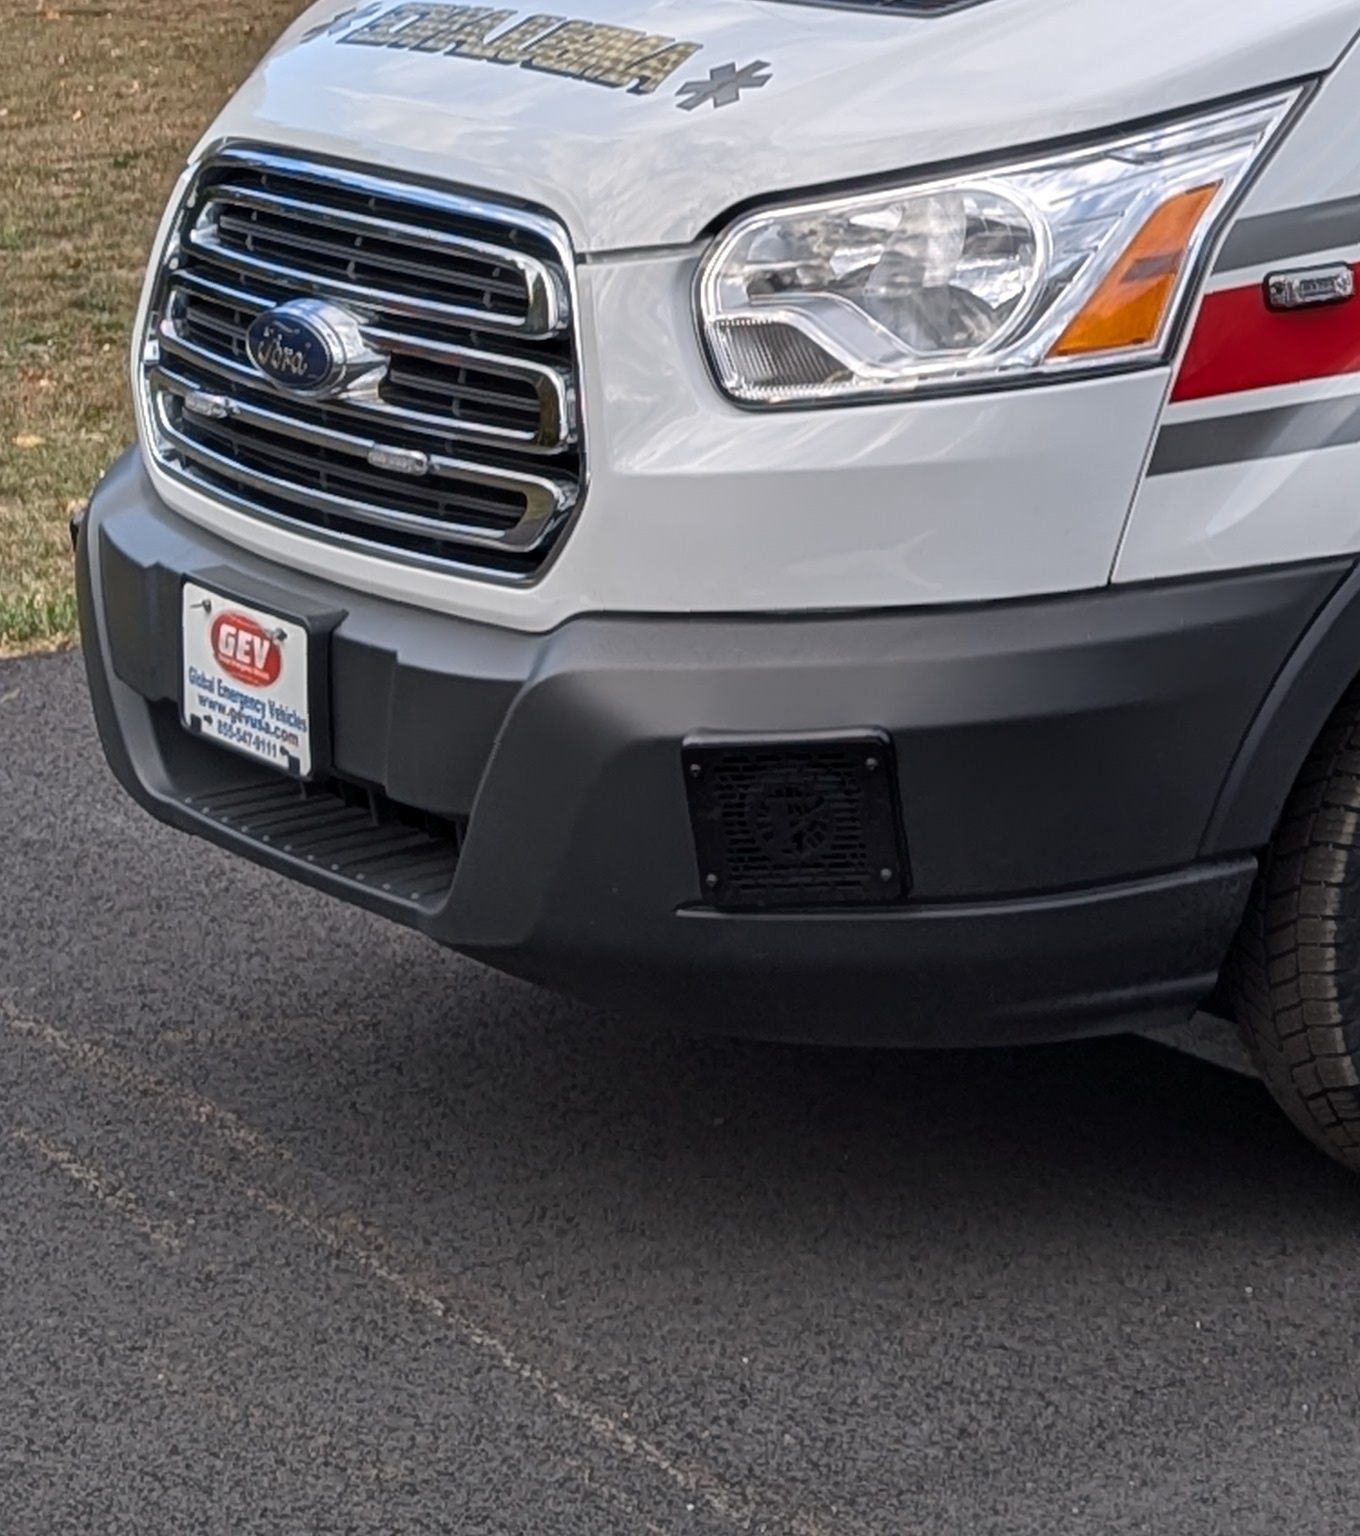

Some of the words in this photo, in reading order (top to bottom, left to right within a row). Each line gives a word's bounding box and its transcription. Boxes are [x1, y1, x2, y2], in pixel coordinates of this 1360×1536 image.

[218, 624, 271, 670] GEV
[189, 665, 215, 694] Global
[217, 677, 266, 719] Emergency
[268, 698, 307, 732] Vehicles
